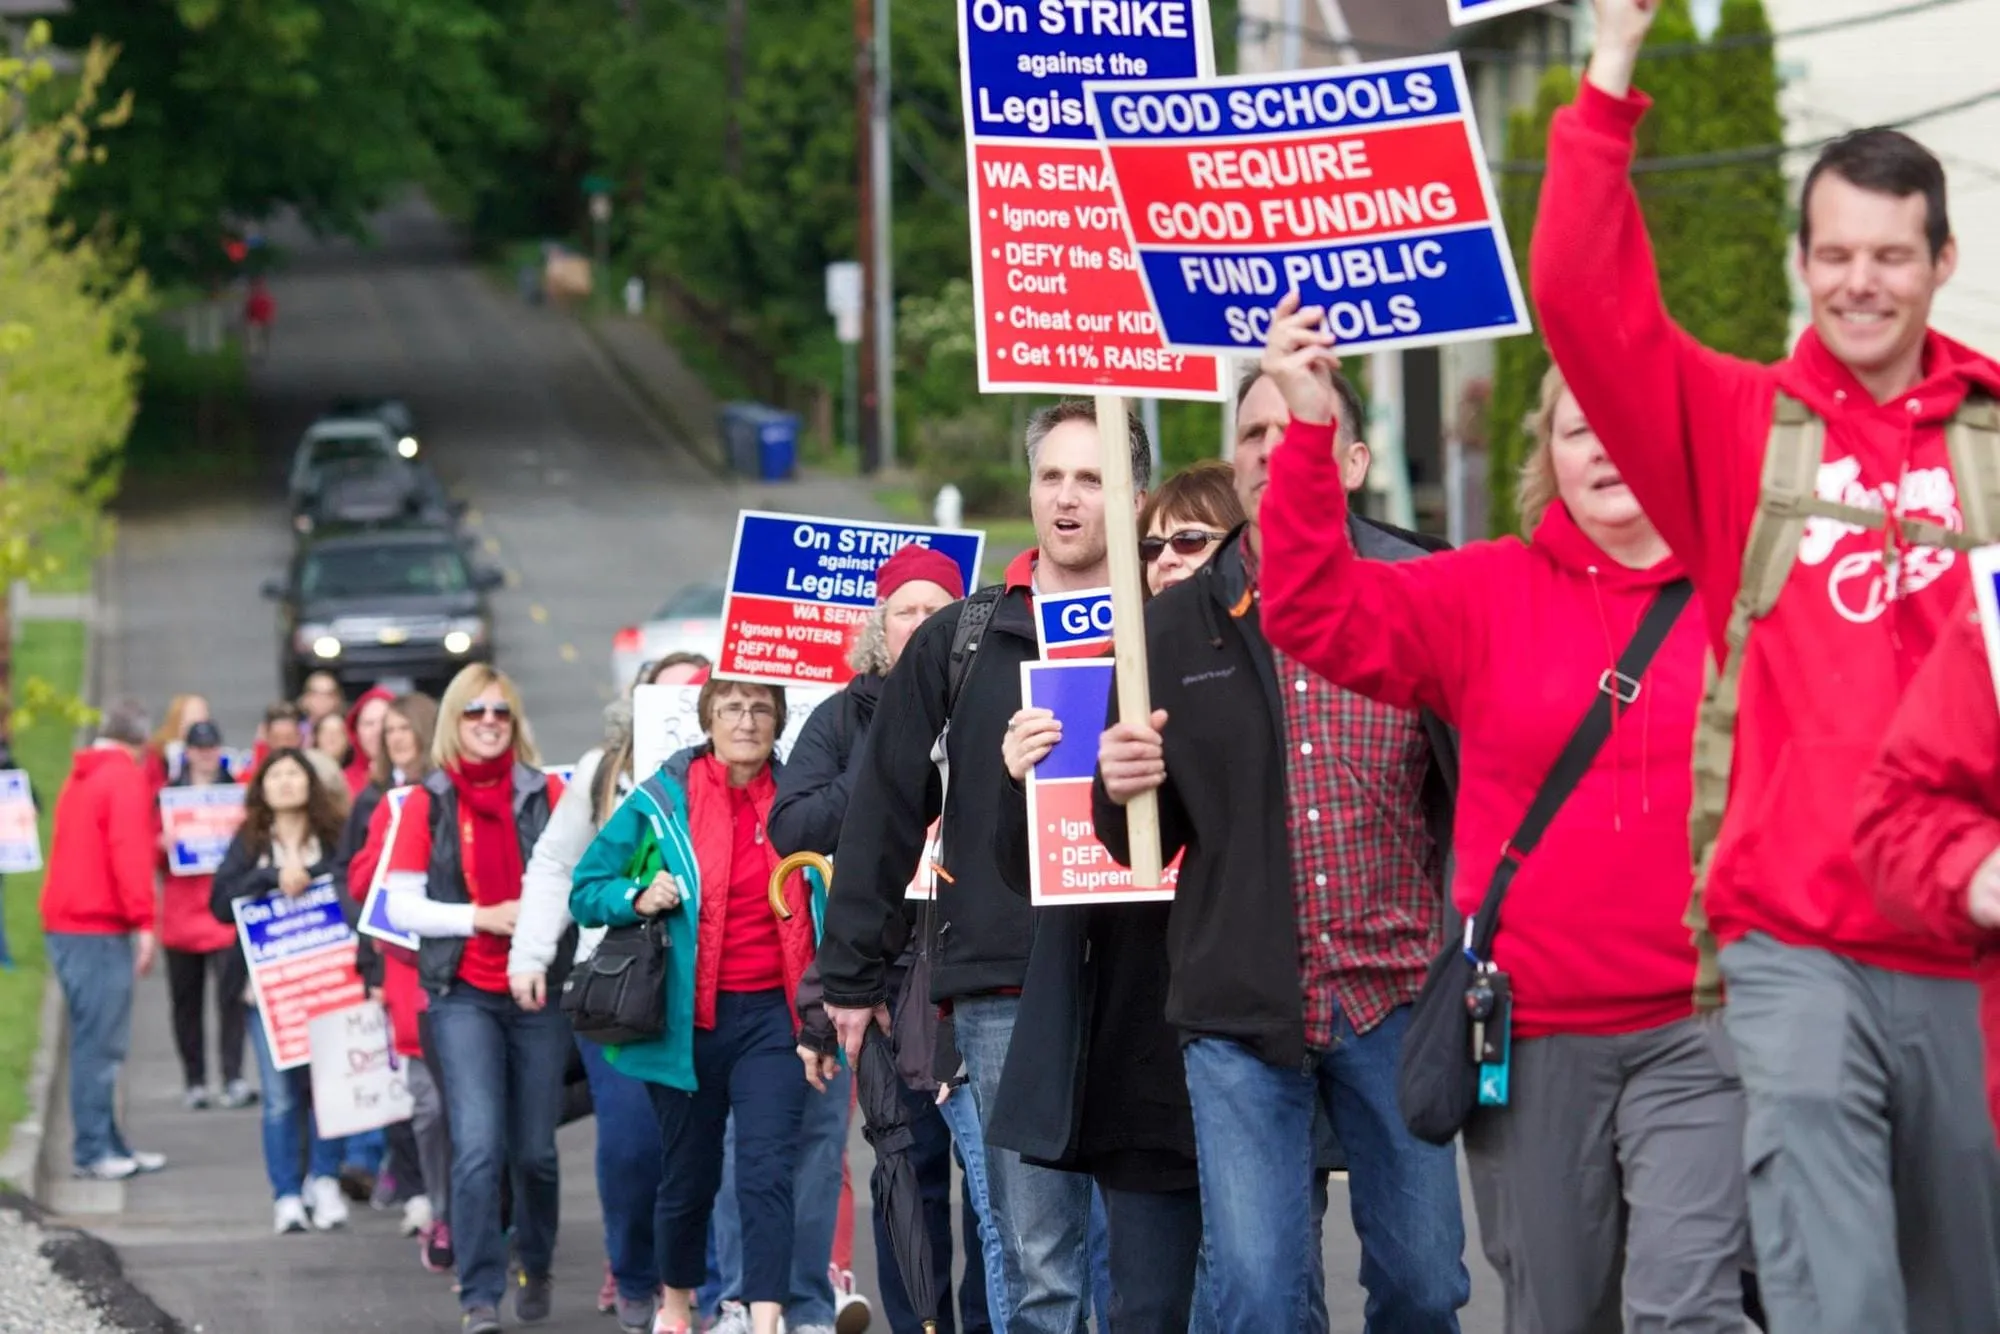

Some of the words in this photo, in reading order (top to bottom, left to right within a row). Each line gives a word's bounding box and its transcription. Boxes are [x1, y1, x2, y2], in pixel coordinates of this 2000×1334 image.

[972, 0, 1028, 32] On
[1038, 0, 1188, 38] STRIKE
[1017, 51, 1104, 77] against
[1109, 53, 1148, 76] the
[1111, 93, 1221, 134] GOOD
[1230, 73, 1438, 130] SCHOOLS
[983, 161, 1031, 189] WA
[1187, 140, 1373, 190] REQUIRE
[1003, 204, 1070, 231] Ignore
[1147, 200, 1254, 240] GOOD
[1262, 182, 1457, 239] FUNDING
[1005, 243, 1064, 267] DEFY
[1069, 244, 1102, 268] the
[1179, 256, 1277, 296] FUND
[1284, 240, 1447, 293] PUBLIC
[1007, 269, 1067, 294] Court
[1010, 306, 1072, 330] Cheat
[1077, 313, 1112, 332] our
[1118, 311, 1158, 334] KID
[1225, 295, 1422, 344] SCOLS
[1012, 342, 1050, 366] Get
[1056, 345, 1098, 368] 11%
[1104, 346, 1185, 372] RAISE?
[793, 524, 831, 550] On
[818, 554, 876, 571] against
[793, 604, 820, 621] WA
[741, 621, 783, 640] Ignore
[786, 625, 842, 644] VOTERS
[737, 642, 774, 659] DEFY
[777, 645, 798, 659] the
[733, 656, 792, 676] Supreme
[795, 662, 833, 679] Court
[1061, 817, 1094, 841] Ign
